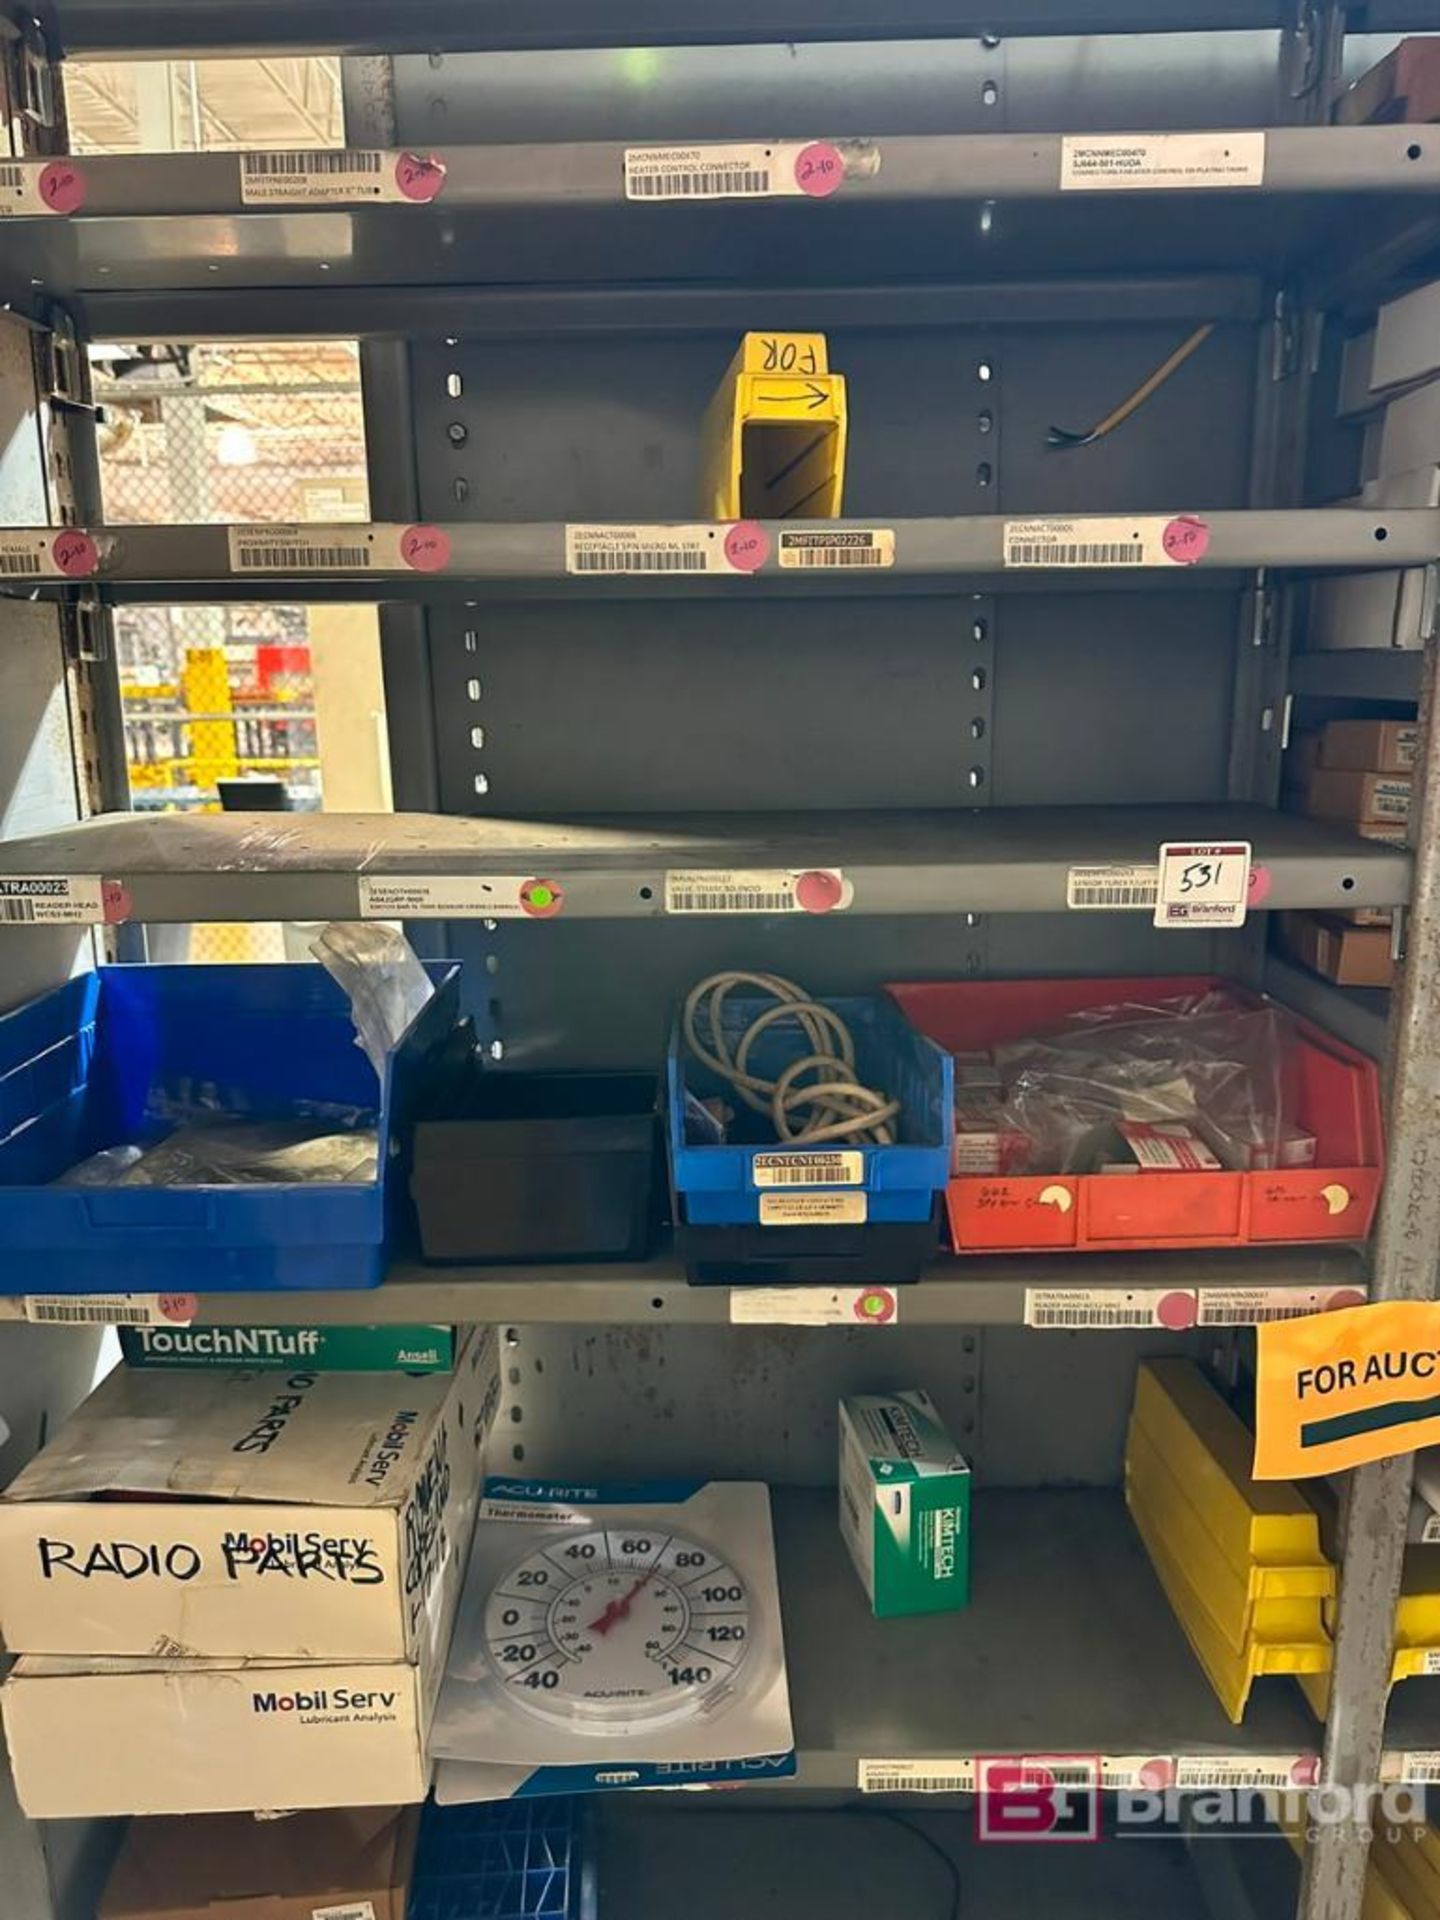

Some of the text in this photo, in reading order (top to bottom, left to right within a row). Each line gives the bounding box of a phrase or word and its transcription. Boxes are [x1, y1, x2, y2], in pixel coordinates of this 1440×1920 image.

[760, 338, 817, 375] FOR
[1180, 861, 1222, 893] 531
[0, 881, 68, 894] TRA00023
[134, 1327, 320, 1356] TouchNTuff
[397, 1349, 438, 1363] Ansell
[1297, 1360, 1357, 1400] FOR
[365, 1408, 419, 1487] Mobil Serv
[487, 1507, 575, 1521] Thermometer
[224, 1531, 368, 1555] Mobil Serv
[565, 1543, 596, 1558] 40
[621, 1539, 651, 1554] 60
[941, 1508, 955, 1578] KIMTECH
[38, 1537, 385, 1584] RADIO PARTS
[676, 1552, 704, 1567] 80
[518, 1570, 549, 1586] 20
[702, 1587, 742, 1602] 100
[502, 1609, 520, 1625] 0
[707, 1625, 745, 1641] 120
[494, 1643, 536, 1662] -20
[514, 1670, 559, 1689] -40
[668, 1667, 711, 1685] 140
[253, 1688, 396, 1713] Mobil Serv
[300, 1712, 397, 1725] Lubricant Analysis
